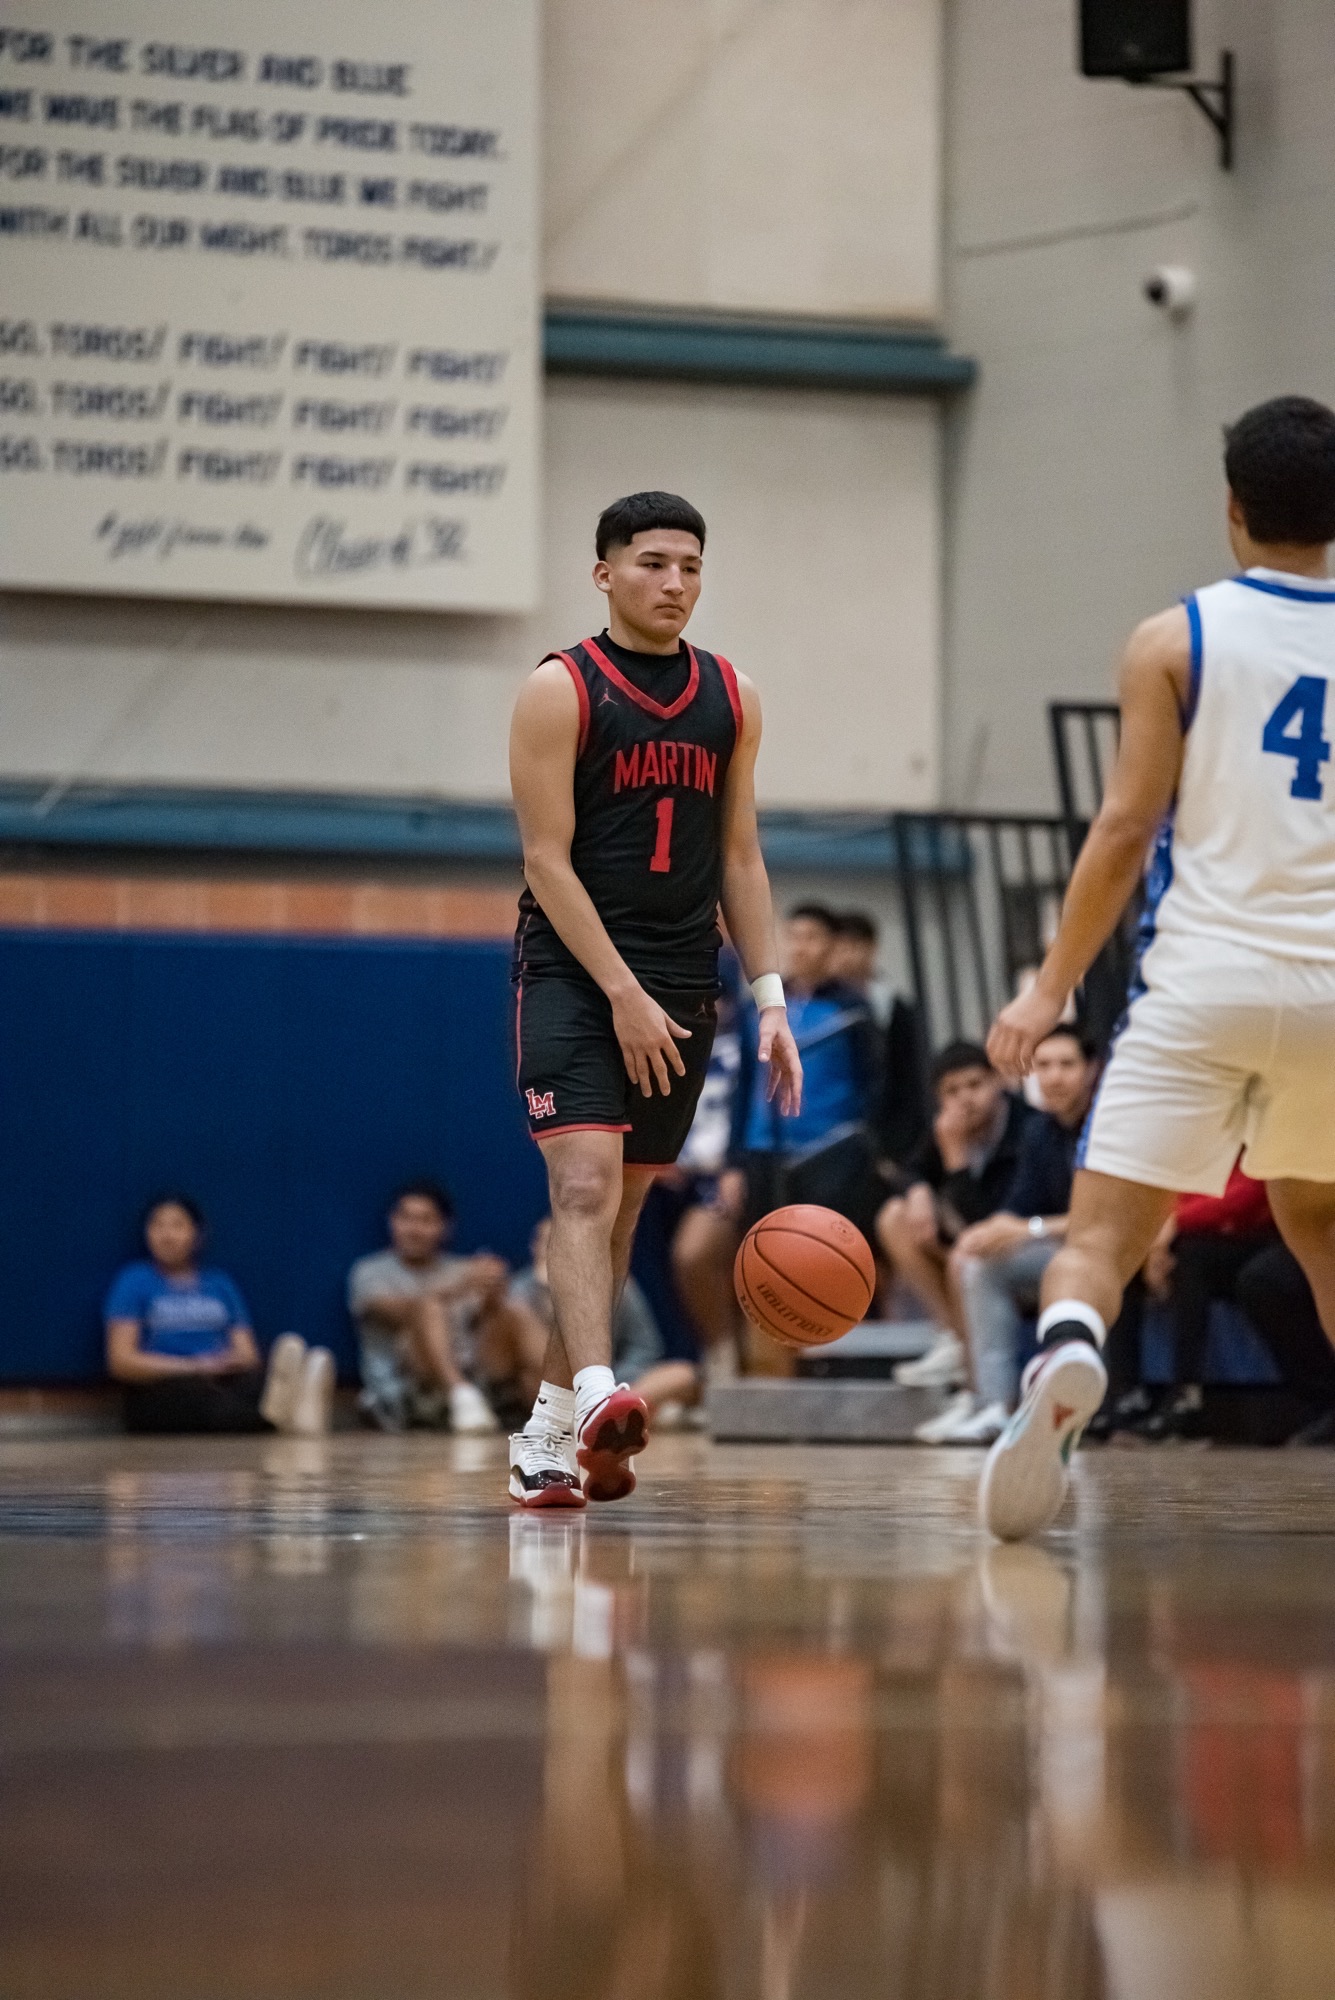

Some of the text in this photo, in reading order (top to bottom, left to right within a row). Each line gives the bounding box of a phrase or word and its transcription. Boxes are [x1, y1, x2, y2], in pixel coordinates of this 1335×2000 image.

[68, 34, 130, 73] THE
[142, 43, 245, 83] SILVER
[258, 54, 322, 88] AND
[45, 95, 119, 131] WAVE
[131, 100, 184, 136] THE
[193, 104, 262, 143] FLAG
[273, 110, 306, 144] OF
[315, 115, 396, 153] PRIDE
[57, 149, 106, 186] THE
[117, 155, 209, 193] SILVER
[216, 162, 269, 199] AND
[282, 168, 346, 203] BLUE
[358, 175, 396, 209] WE
[406, 179, 490, 214] FIGHT
[0, 206, 70, 236] WITH
[74, 209, 124, 248] ALL
[132, 212, 191, 250] OUR
[1262, 675, 1331, 801] 4
[614, 741, 717, 798] MARTIN
[650, 797, 675, 873] 1
